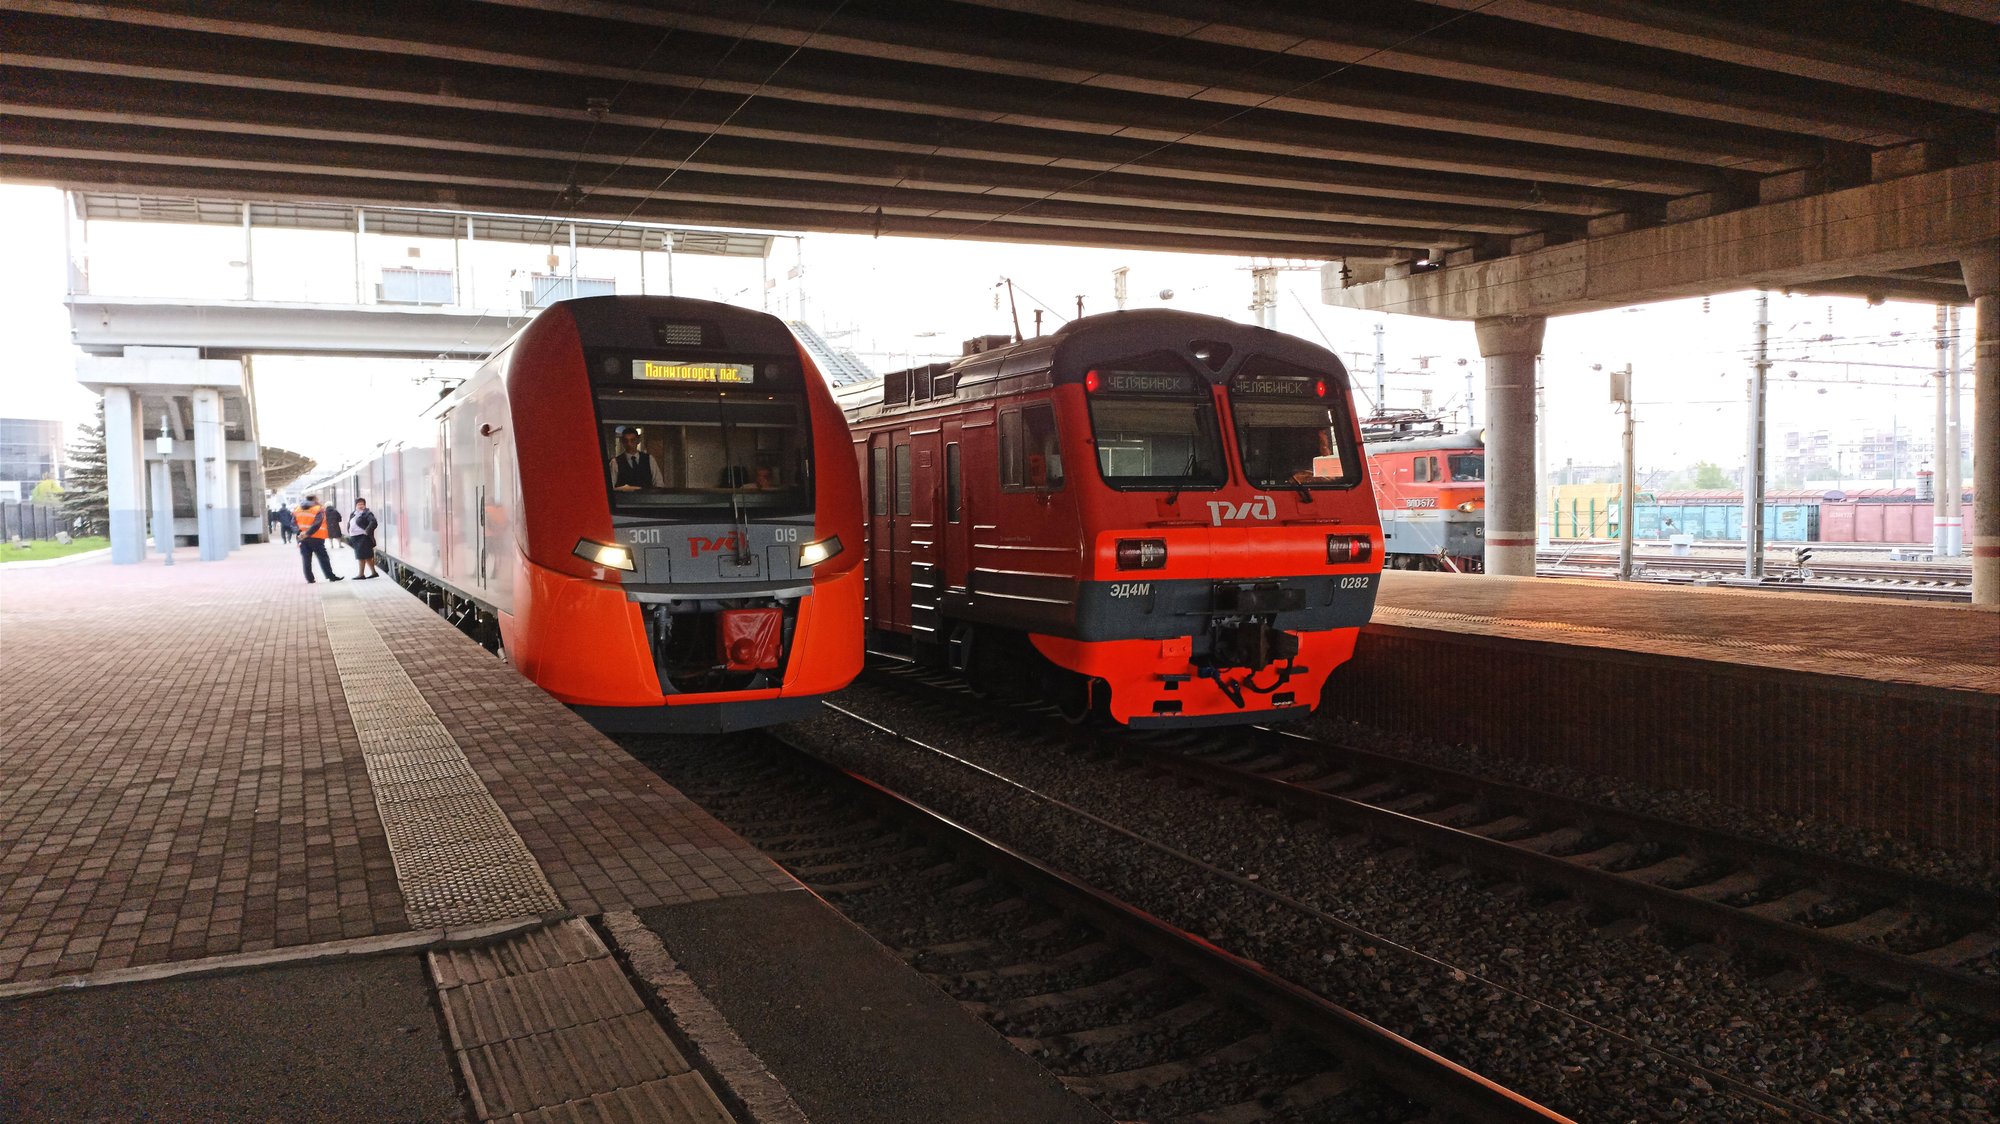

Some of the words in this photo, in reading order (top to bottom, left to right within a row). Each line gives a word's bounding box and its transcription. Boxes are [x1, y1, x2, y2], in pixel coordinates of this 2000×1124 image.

[645, 362, 716, 381] Магнитогорск
[720, 368, 742, 380] пас.
[1108, 375, 1182, 390] ЧЕЛЯБИНСК
[1235, 380, 1303, 394] ЧЕЛЯБИНСК
[775, 528, 798, 542] 019
[1340, 577, 1369, 590] 0282
[1110, 583, 1150, 599] ЭД4М
